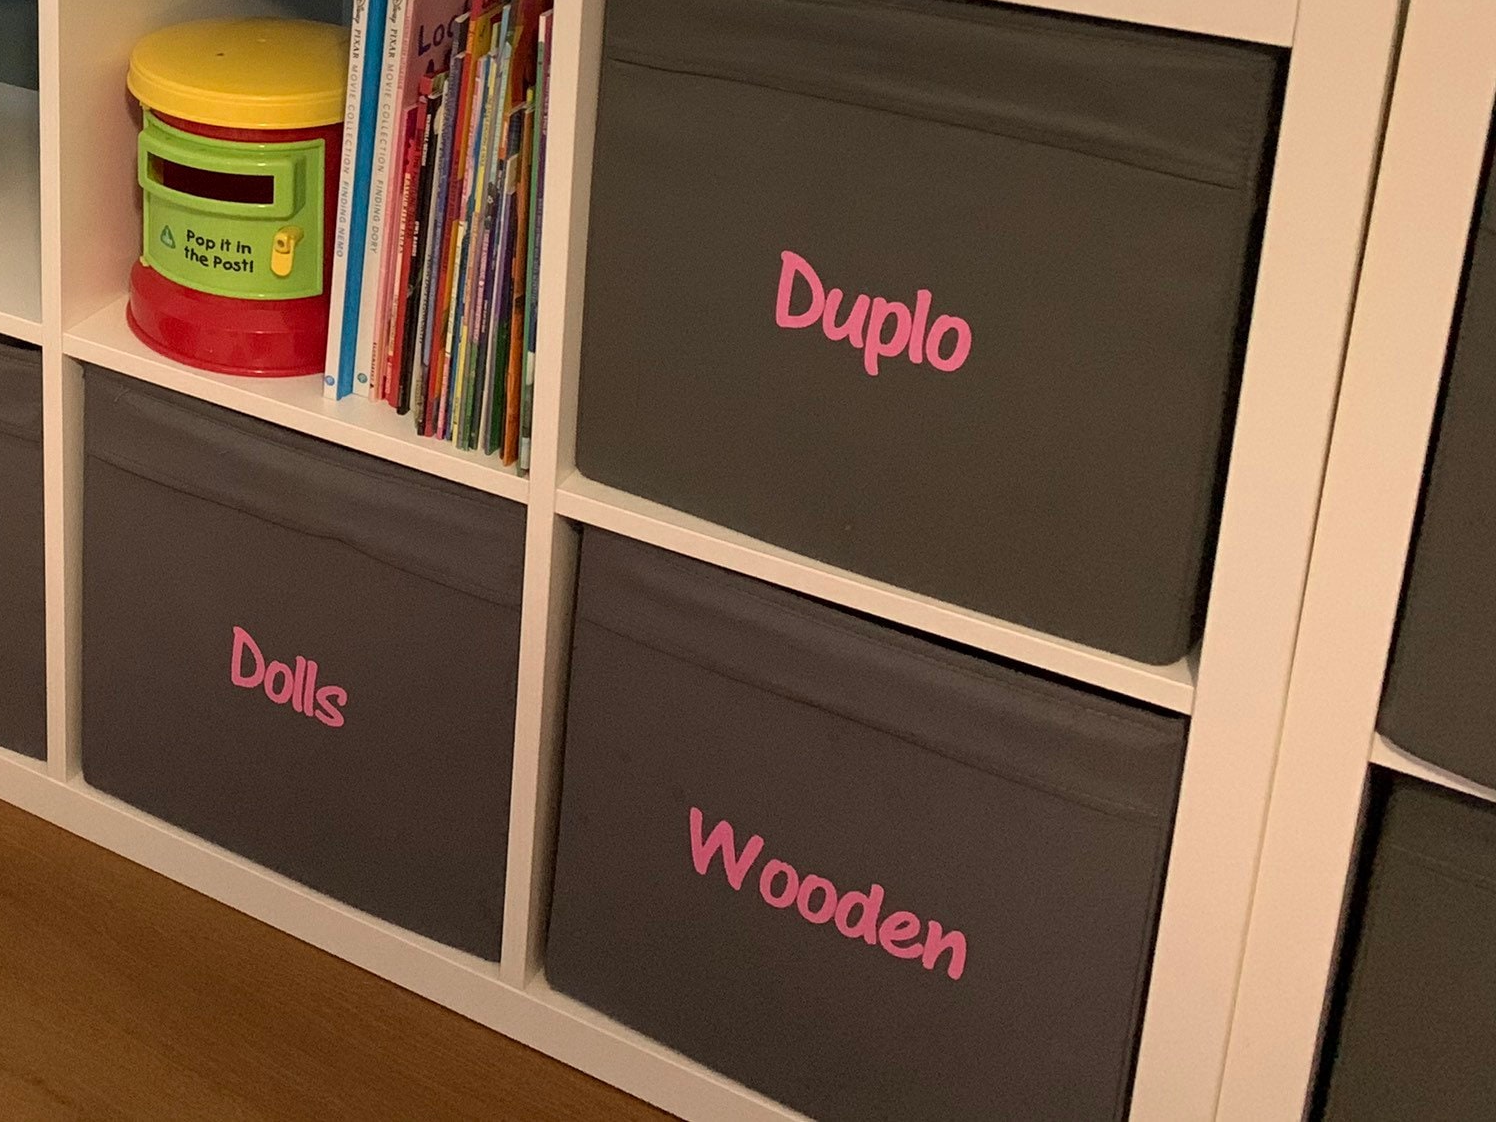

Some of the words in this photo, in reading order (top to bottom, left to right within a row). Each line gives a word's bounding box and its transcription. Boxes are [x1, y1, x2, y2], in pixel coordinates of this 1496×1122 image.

[351, 28, 362, 59] PIXAR
[387, 28, 398, 59] PIXAR
[348, 64, 359, 100] MOVIE
[383, 64, 395, 100] MOVIE
[343, 103, 356, 175] COLLECTION
[377, 103, 392, 173] COLLECTION
[338, 180, 350, 224] FINDING
[372, 179, 384, 222] FINDING
[186, 229, 216, 251] Pop
[236, 241, 252, 254] in
[335, 226, 346, 258] NEMO
[369, 225, 380, 254] DORY
[184, 246, 210, 267] the
[213, 255, 254, 273] Post!
[776, 250, 972, 376] Duplo
[231, 626, 348, 727] Dolls
[690, 806, 967, 980] Wooden
